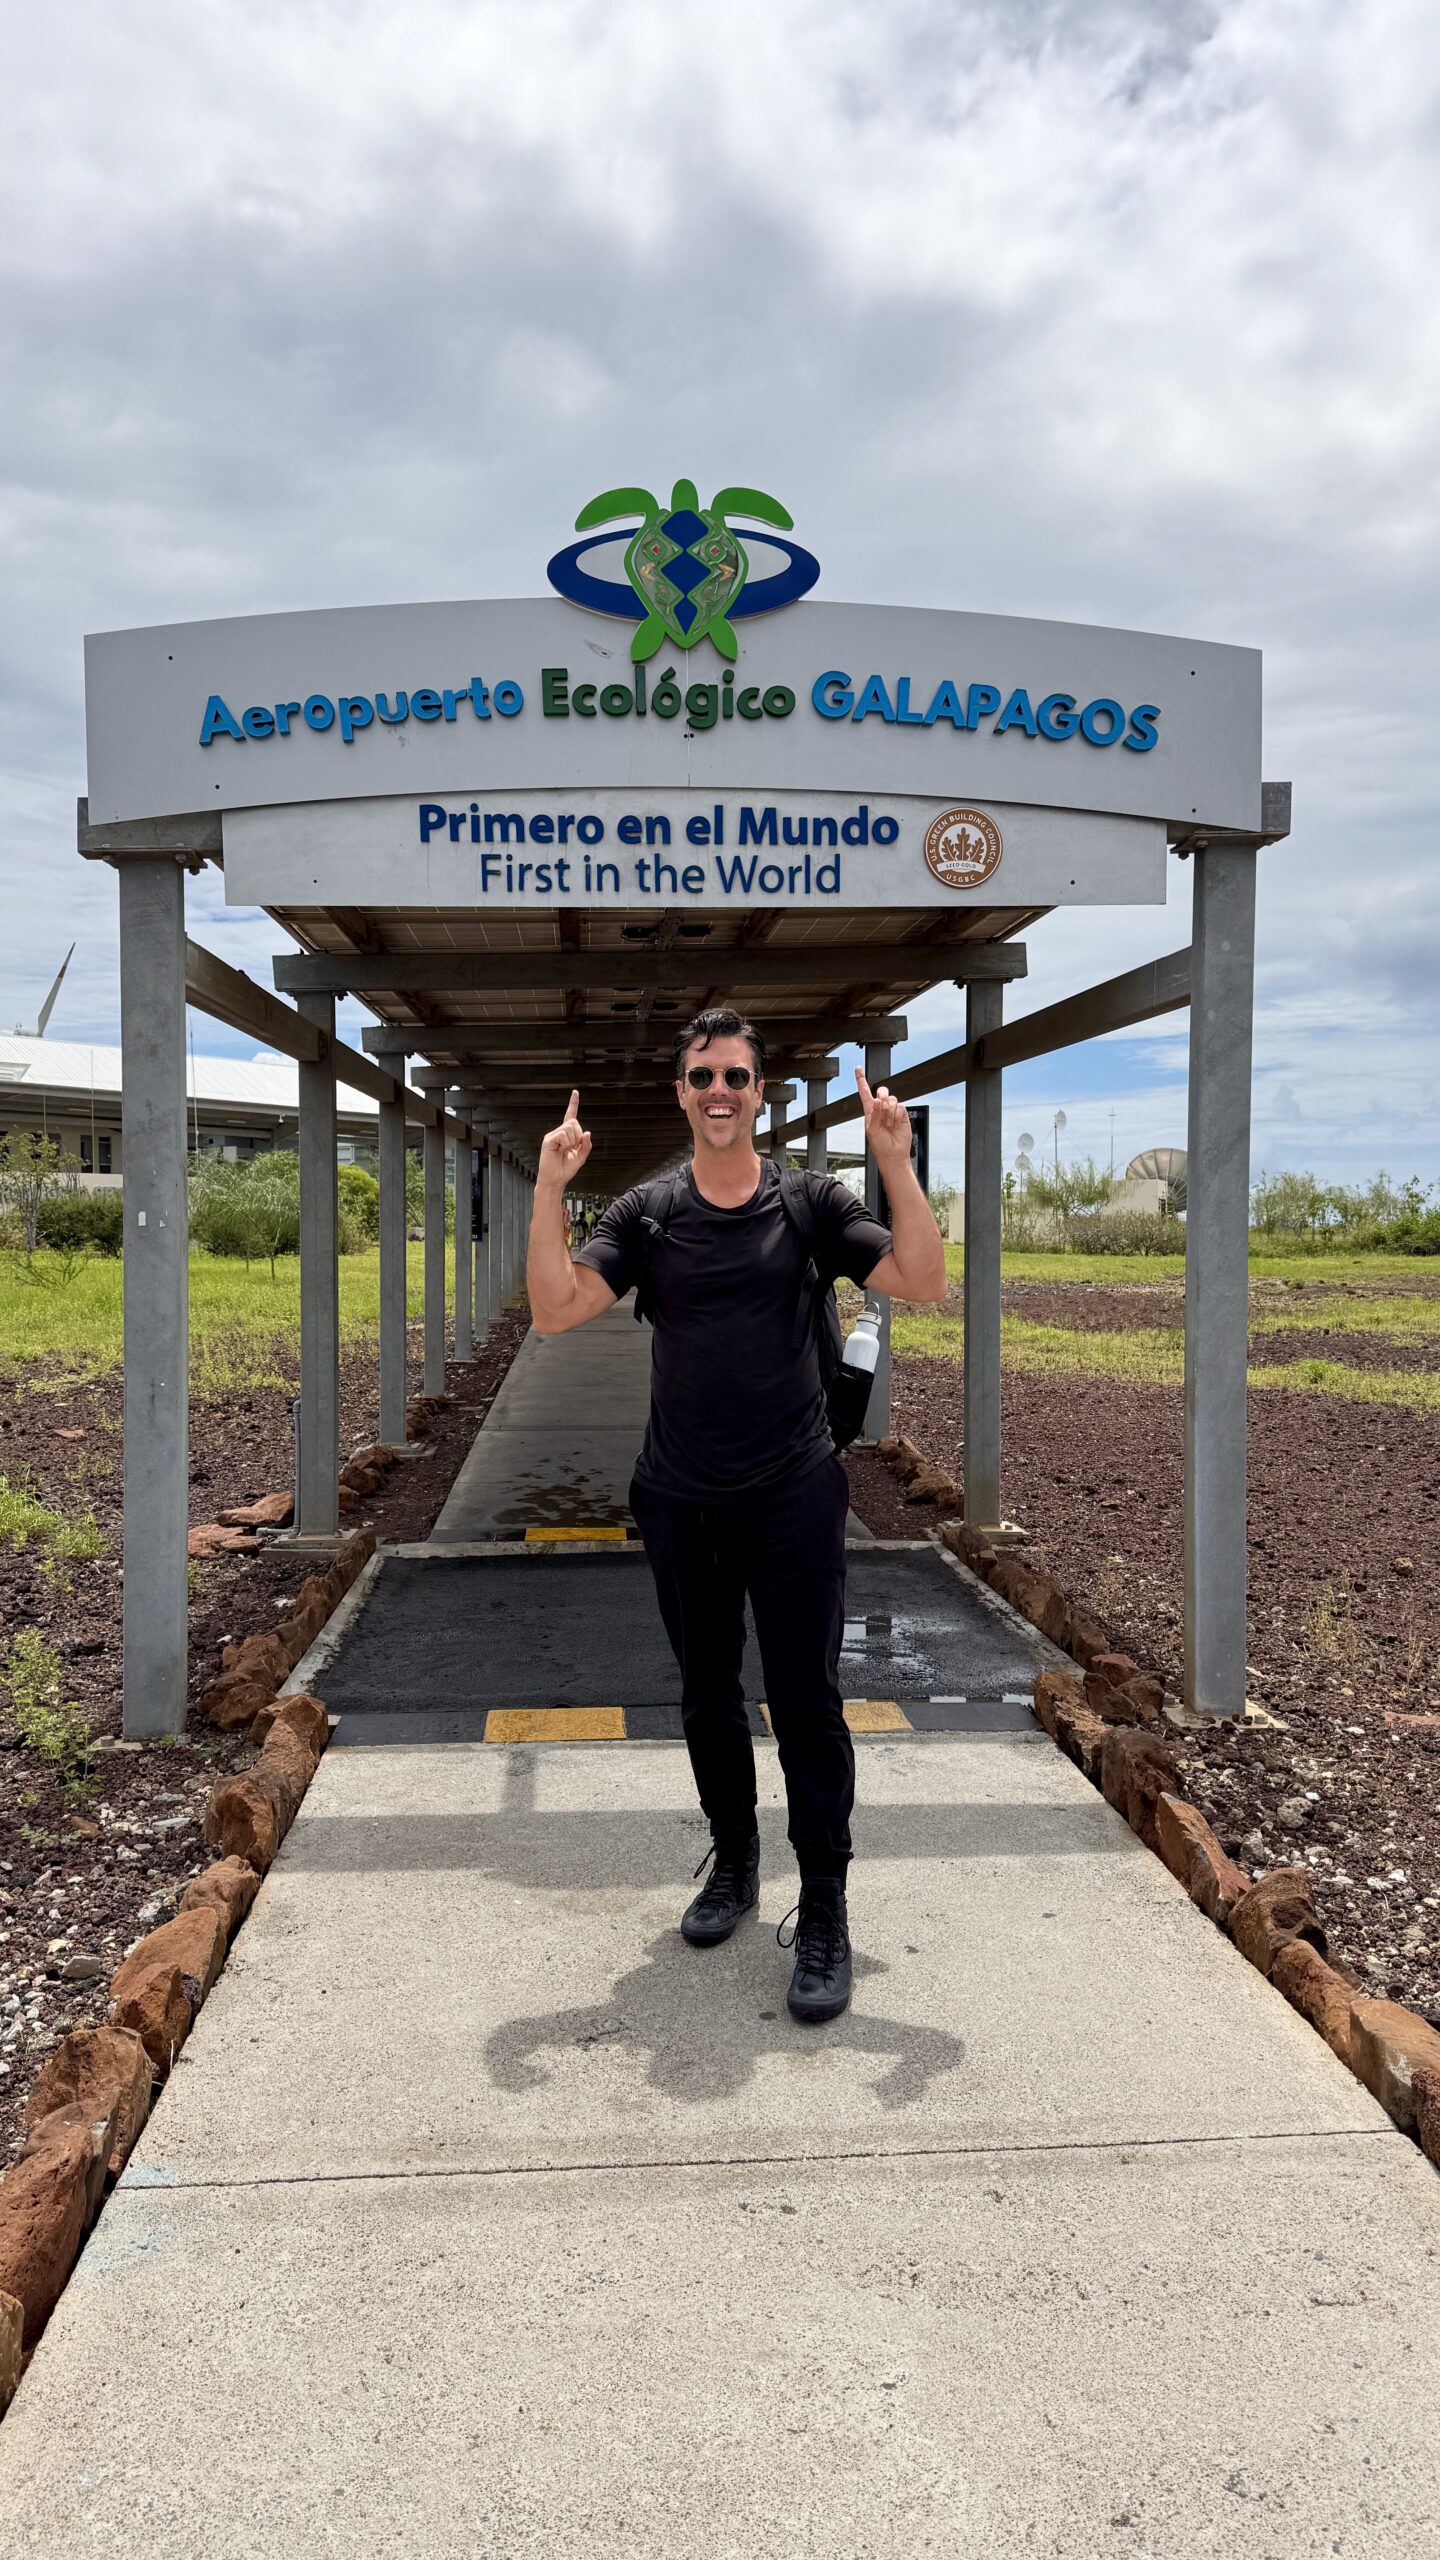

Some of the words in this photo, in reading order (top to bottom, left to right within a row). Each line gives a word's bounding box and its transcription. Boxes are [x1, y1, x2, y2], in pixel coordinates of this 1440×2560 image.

[199, 676, 524, 747] Aeropuerto
[541, 664, 797, 730] Ecológico
[811, 670, 1161, 752] GALAPAGOS
[418, 802, 605, 846] Primero
[616, 814, 671, 846] en
[685, 804, 724, 846] el
[738, 804, 900, 846] Mundo
[930, 820, 948, 845] GREEN
[948, 813, 987, 828] BUILDING
[985, 828, 997, 863] COUNCIL
[480, 853, 570, 893] First
[584, 854, 620, 893] in
[634, 852, 705, 894] the
[715, 853, 841, 894] World
[946, 874, 976, 883] USGBC
